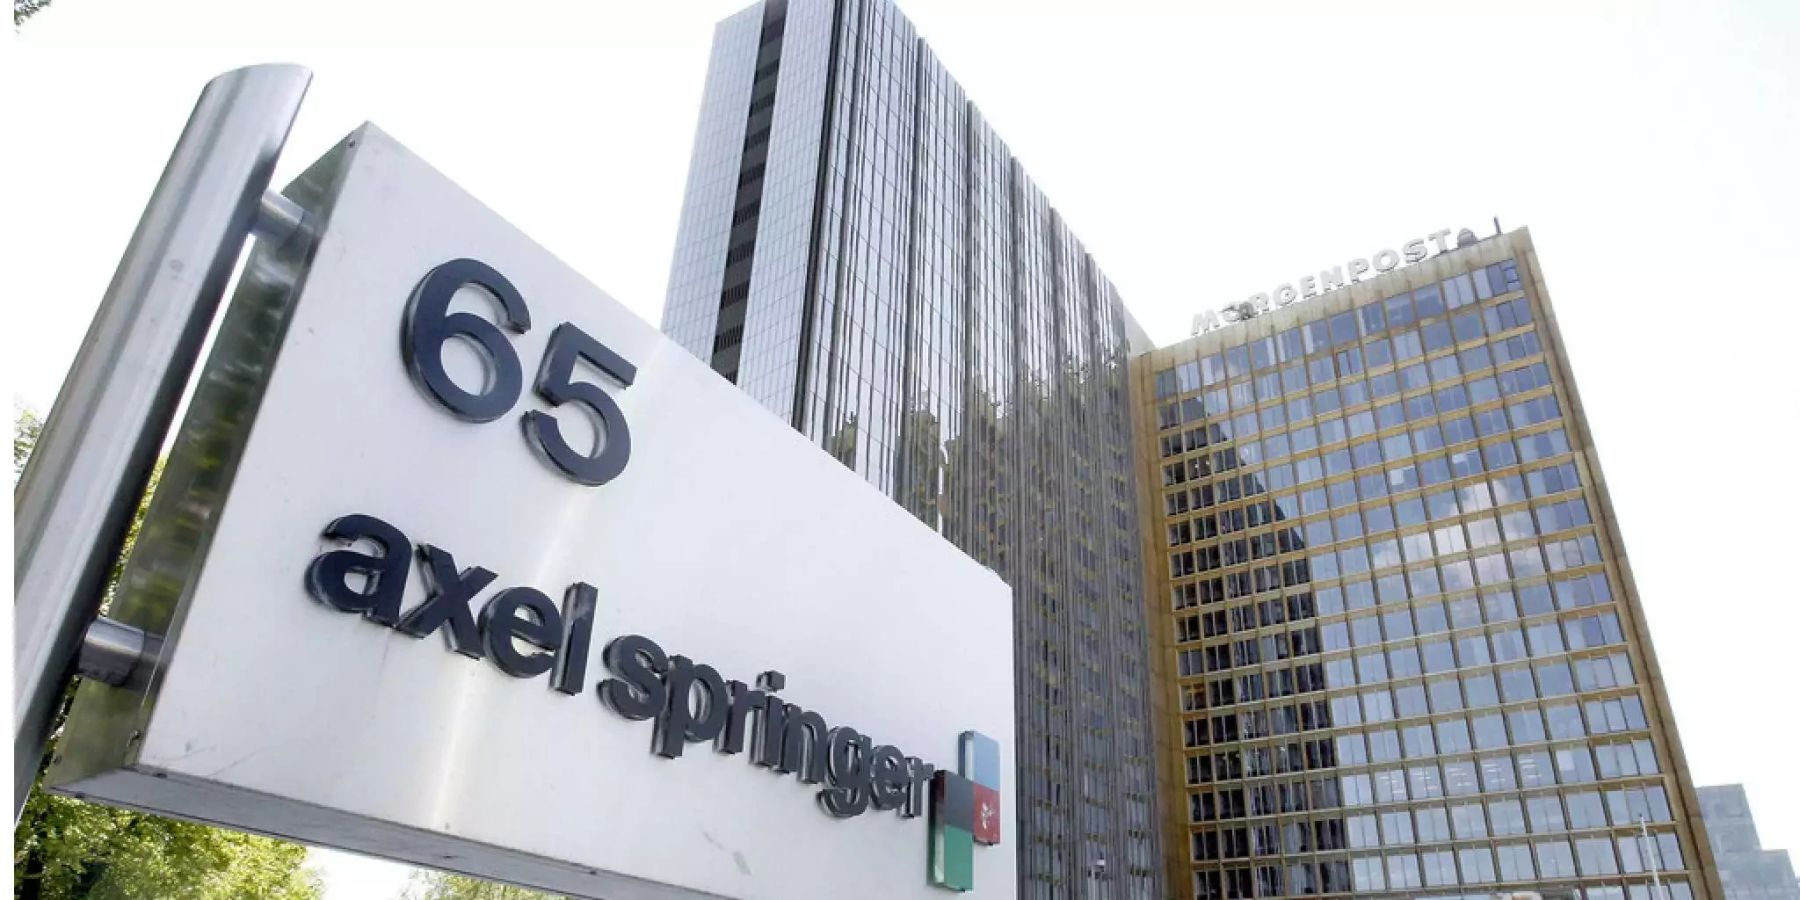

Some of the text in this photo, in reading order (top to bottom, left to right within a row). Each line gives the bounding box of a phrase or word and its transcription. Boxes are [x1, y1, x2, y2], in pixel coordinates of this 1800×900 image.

[402, 257, 638, 487] 65
[304, 513, 934, 818] axel springer
